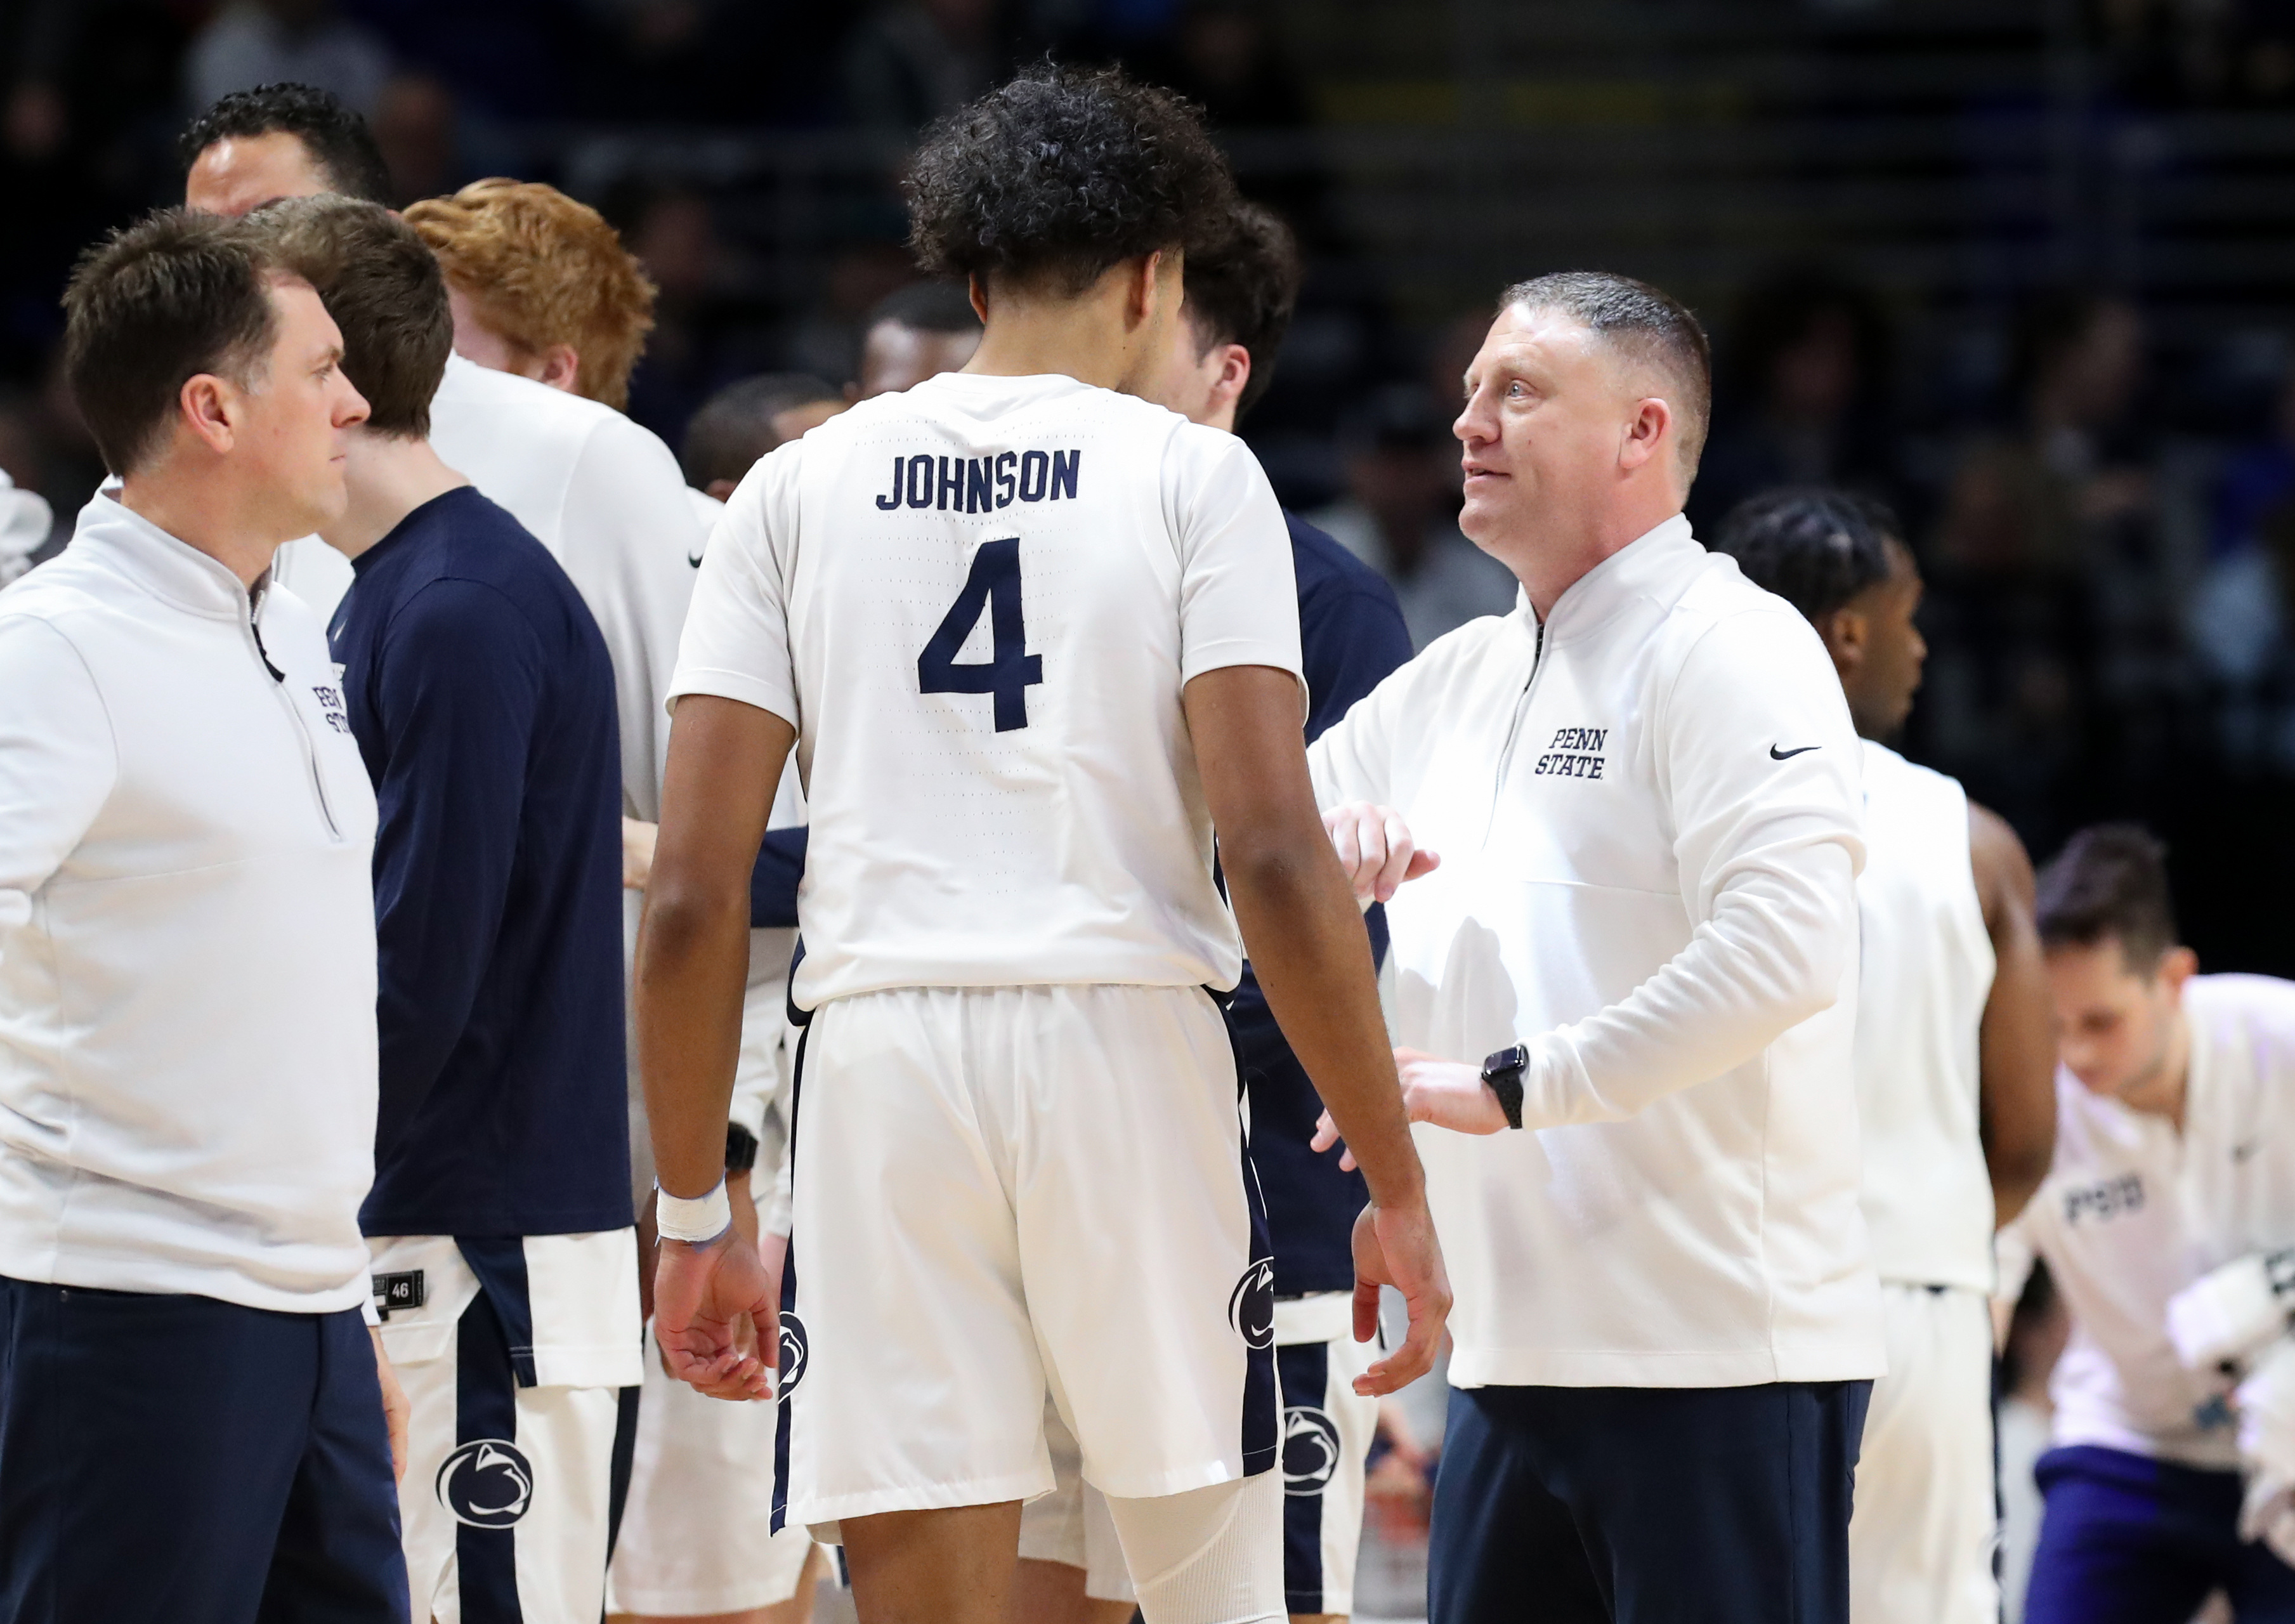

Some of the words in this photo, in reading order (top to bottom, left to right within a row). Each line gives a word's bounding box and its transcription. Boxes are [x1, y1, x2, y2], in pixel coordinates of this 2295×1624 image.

[876, 449, 1080, 514] JOHNSON
[917, 537, 1042, 733] 4
[1548, 728, 1608, 751] PENN
[1535, 754, 1605, 779] STATE
[392, 1282, 409, 1298] 46
